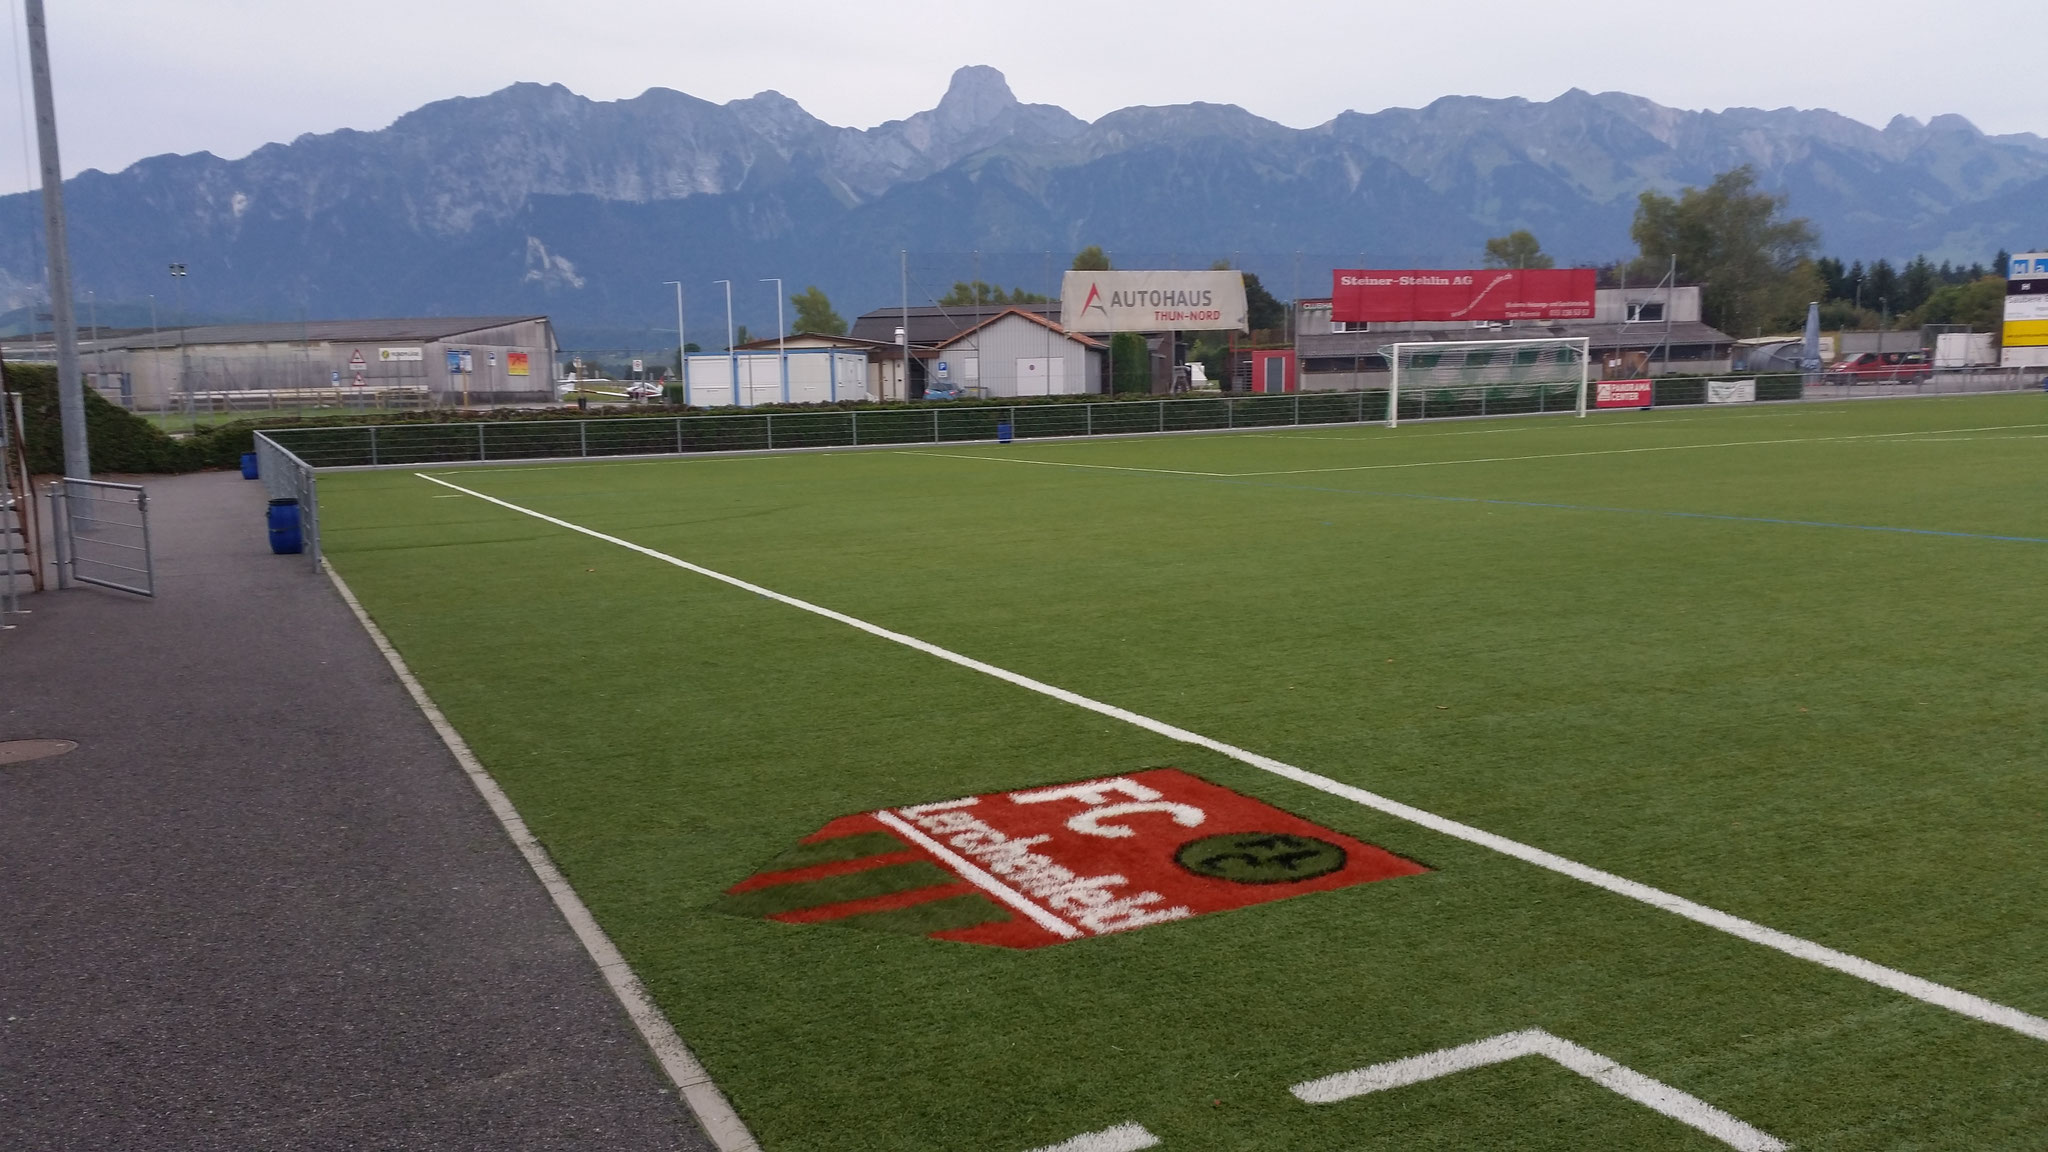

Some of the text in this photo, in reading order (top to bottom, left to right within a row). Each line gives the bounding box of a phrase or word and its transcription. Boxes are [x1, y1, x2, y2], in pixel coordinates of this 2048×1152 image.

[1340, 275, 1449, 286] Steiner-Stehlin
[1453, 275, 1473, 286] AG
[1111, 289, 1212, 308] AUTOHAUS
[1154, 310, 1221, 321] THUN-NORD
[1611, 383, 1651, 392] PANORAMA
[1611, 392, 1640, 401] CENTER
[1008, 776, 1206, 839] FC
